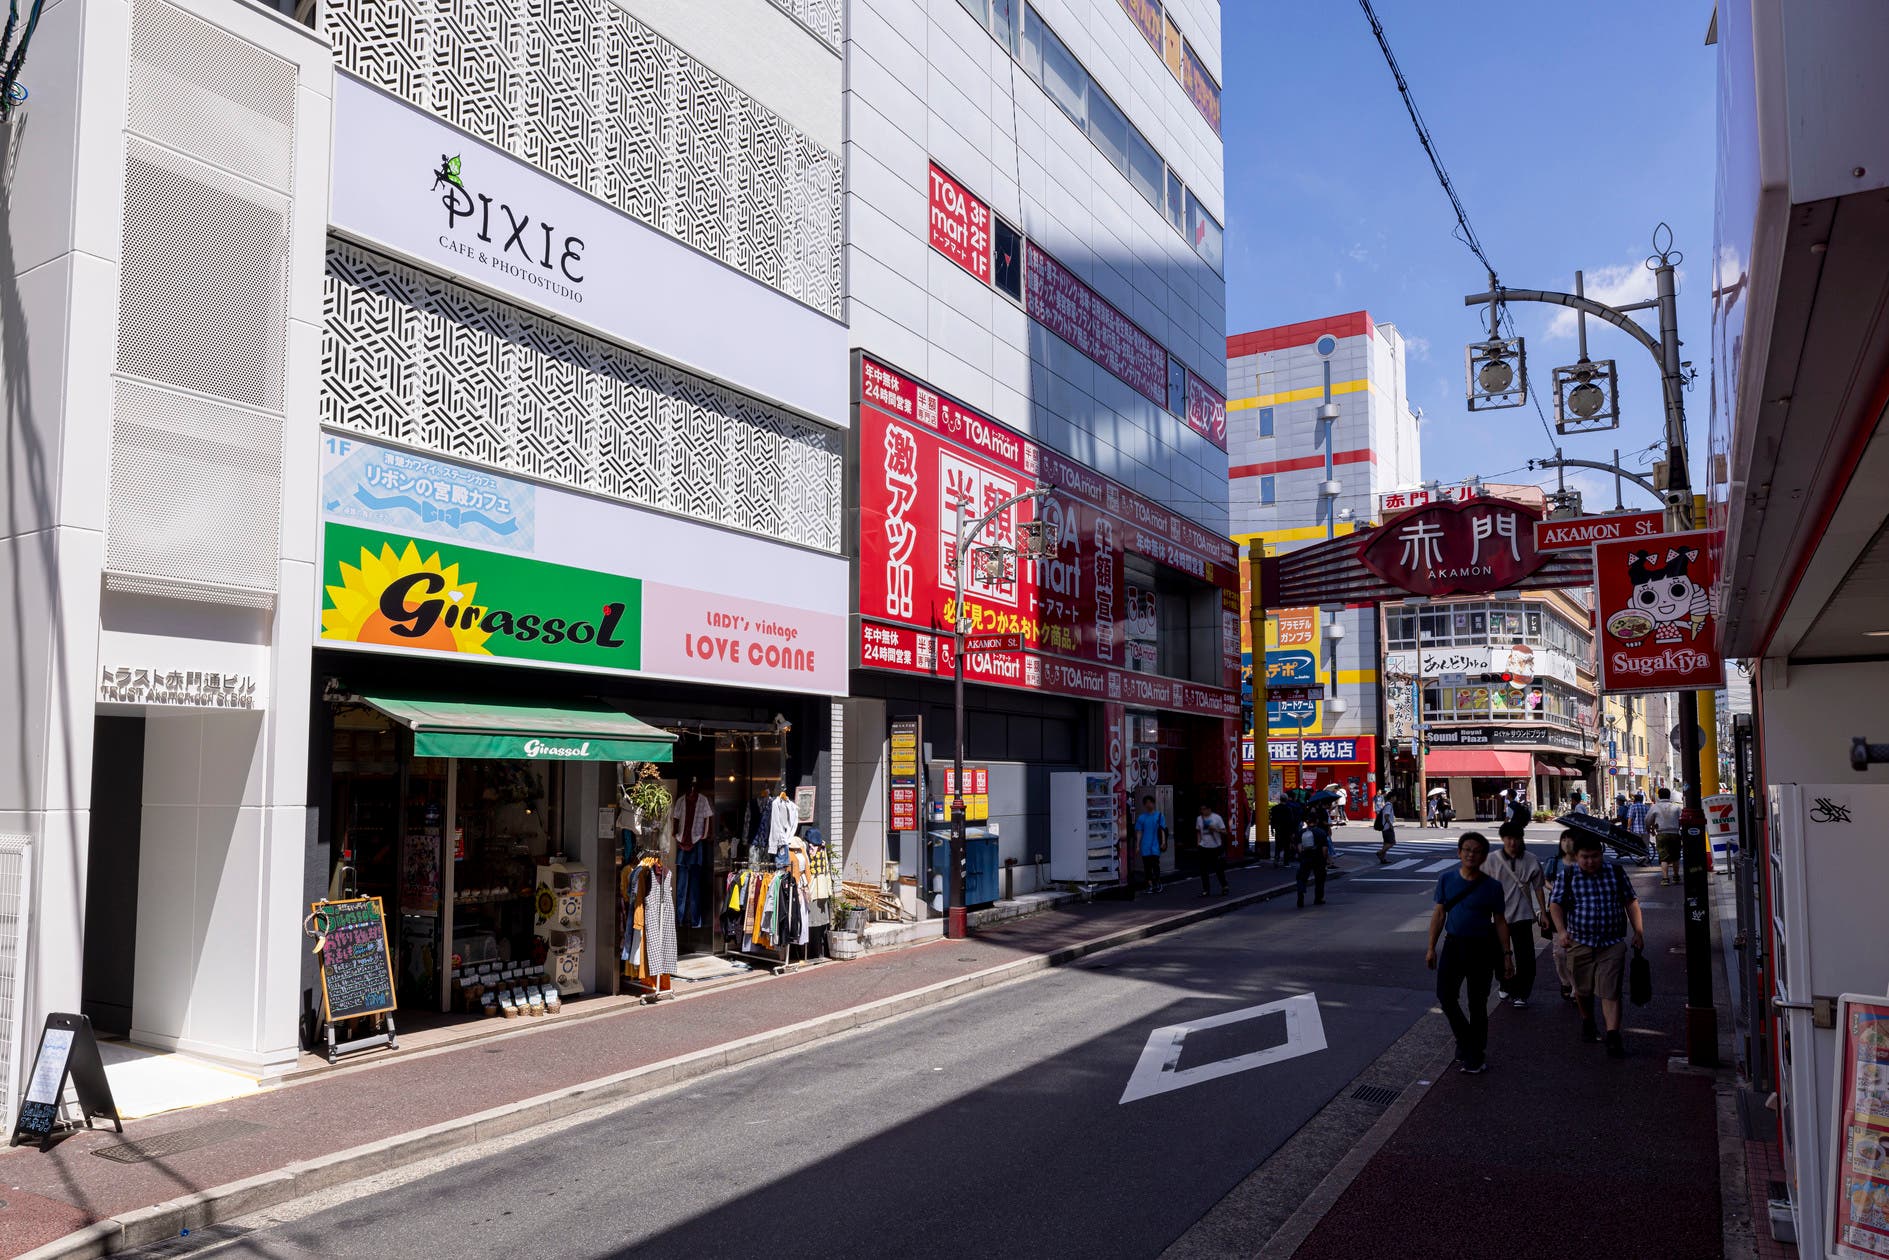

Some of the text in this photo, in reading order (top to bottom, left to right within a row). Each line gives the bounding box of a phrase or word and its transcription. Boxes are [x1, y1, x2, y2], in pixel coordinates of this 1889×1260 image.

[930, 171, 967, 223] TOA
[931, 206, 968, 242] mart
[970, 202, 987, 226] 3F
[440, 180, 585, 283] PIXIE
[970, 228, 987, 252] 2F
[439, 236, 583, 304] CAFE & PHOTOSTUDIO
[971, 250, 987, 275] 1F
[865, 364, 899, 391] 年中無休
[865, 380, 912, 414] 24時間営業
[917, 388, 937, 413] 半額
[326, 438, 351, 456] 1F
[366, 464, 510, 513] リボンの宮殿カフェ
[1385, 486, 1477, 509] 赤門ル
[885, 422, 917, 618] 激アツ品
[1544, 519, 1657, 544] AKAMON St.
[1398, 512, 1521, 570] 赤門
[1429, 565, 1492, 580] AKAMON
[1030, 592, 1079, 623] トーアマート
[707, 611, 798, 642] LADY's vintage
[864, 626, 899, 645] 年中無休
[1280, 620, 1312, 630] プラモデル
[1280, 632, 1312, 642] ガンプラ
[685, 633, 815, 673] LOVE CONNE
[864, 643, 912, 665] 24時間営業
[967, 638, 1001, 649] AKAMON
[1241, 661, 1299, 680] ゲデポ
[1613, 650, 1709, 675] Sugakiya
[102, 664, 257, 691] トラスト赤門通ビル
[101, 685, 144, 702] TRUST
[1281, 700, 1314, 710] カードゲーム
[1426, 732, 1458, 742] Sound
[1242, 744, 1298, 758] TA FREE
[1303, 742, 1353, 759] 免税店
